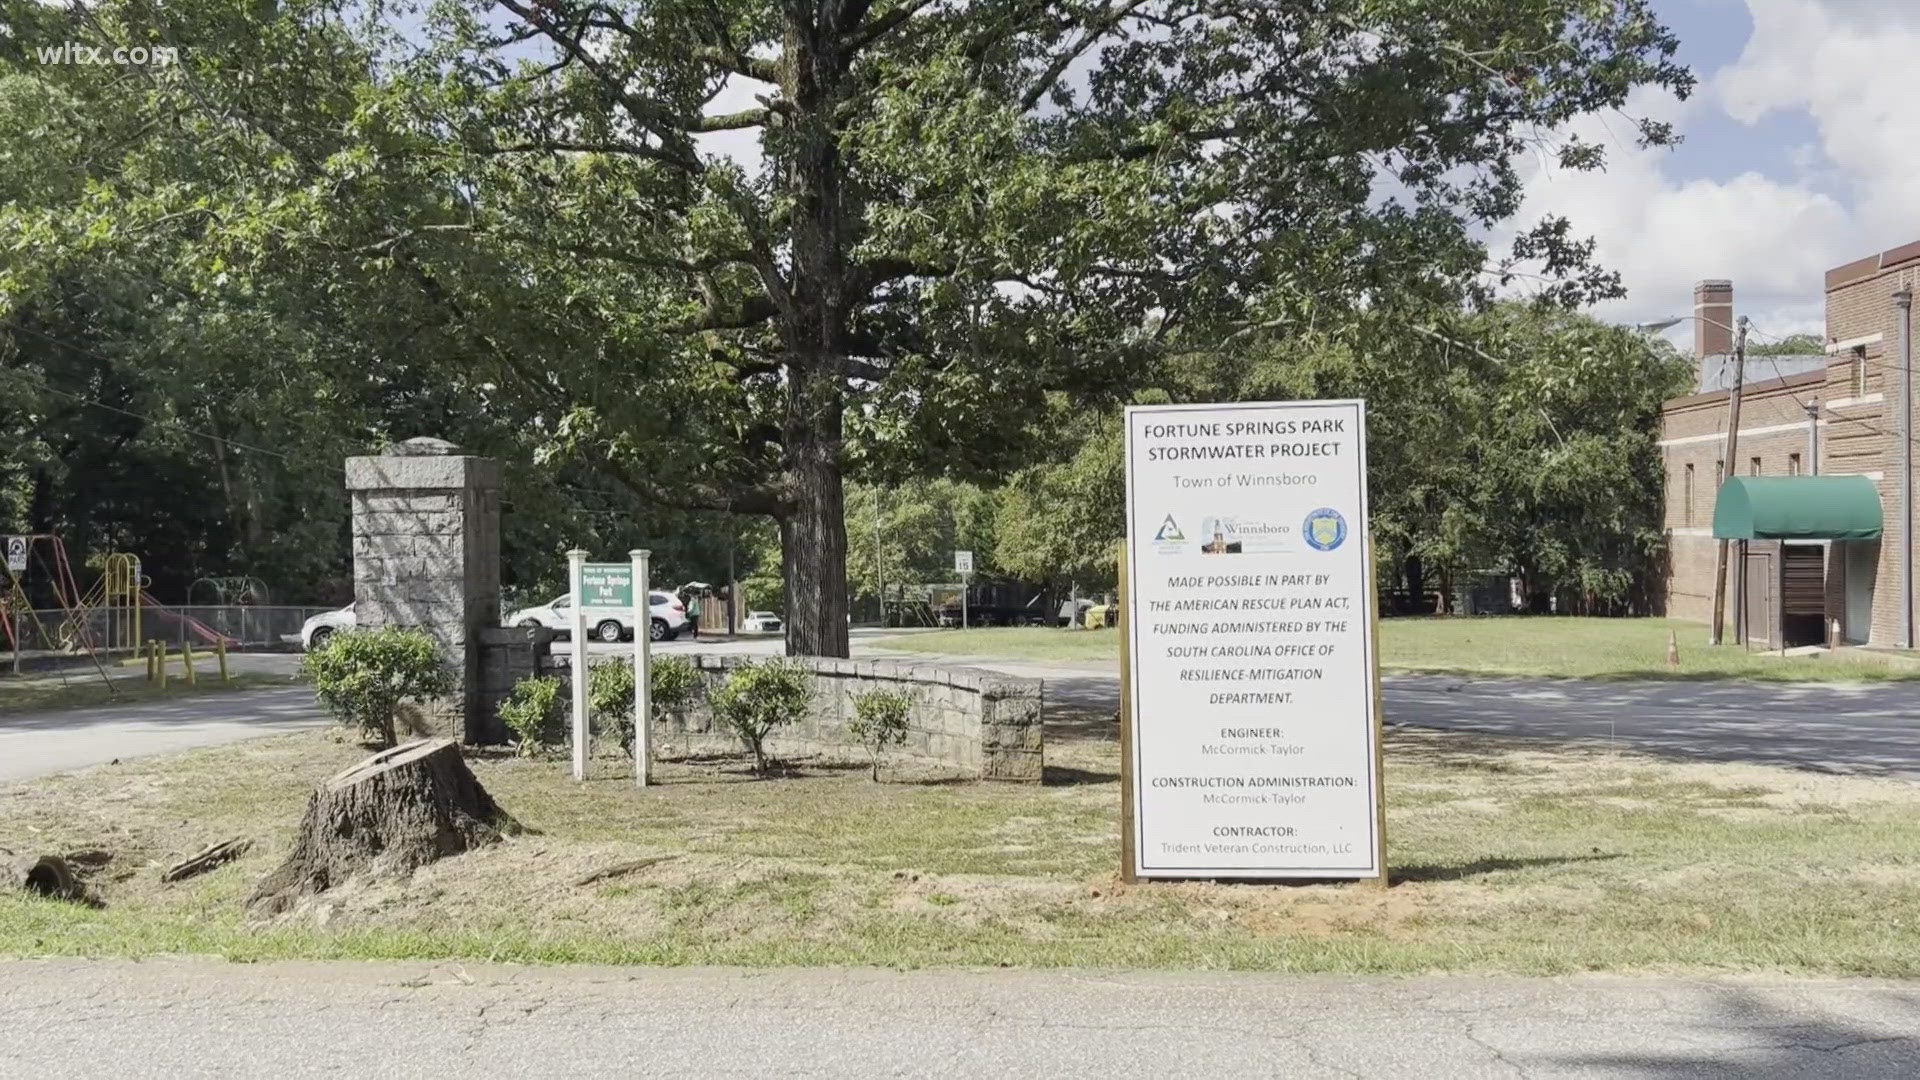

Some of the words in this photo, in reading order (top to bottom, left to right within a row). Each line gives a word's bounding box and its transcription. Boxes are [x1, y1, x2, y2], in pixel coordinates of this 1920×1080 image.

[1144, 423, 1220, 439] FORTUNE
[1225, 421, 1296, 436] SPRINGS
[1301, 419, 1345, 434] PARK
[1148, 445, 1265, 461] STORMWATER
[1270, 442, 1341, 457] PROJECT
[1172, 475, 1213, 489] Town
[1217, 473, 1232, 487] of
[1236, 472, 1317, 487] Winnsboro
[1224, 522, 1290, 535] Winnsboro
[959, 561, 969, 570] 15
[1167, 576, 1204, 588] MADE
[1207, 575, 1262, 588] POSSIBLE
[1264, 575, 1278, 586] IN
[1280, 574, 1312, 586] PART
[1314, 574, 1330, 586] BY
[1149, 600, 1171, 612] THE
[1173, 599, 1239, 611] AMERICAN
[1241, 598, 1286, 610] RESCUE
[1289, 598, 1323, 610] PLAN
[1324, 596, 1351, 610] ACT,
[1153, 623, 1208, 635] FUNDING
[1210, 621, 1303, 634] ADMINISTERED
[1305, 621, 1322, 633] BY
[1324, 620, 1348, 633] THE
[1166, 646, 1208, 658] SOUTH
[1210, 645, 1272, 657] CAROLINA
[1274, 644, 1316, 657] OFFICE
[1318, 644, 1335, 656] OF
[1209, 692, 1294, 705] DEPARTMENT.
[1220, 727, 1285, 739] ENGINEER:
[1151, 777, 1245, 788] CONSTRUCTION
[1248, 775, 1358, 788] ADMINISTRATION:
[1212, 826, 1298, 837] CONTRACTOR:
[1161, 841, 1201, 854] Trident
[1204, 842, 1249, 854] Veteran
[1251, 841, 1330, 856] Construction,
[1332, 842, 1353, 854] LLC
